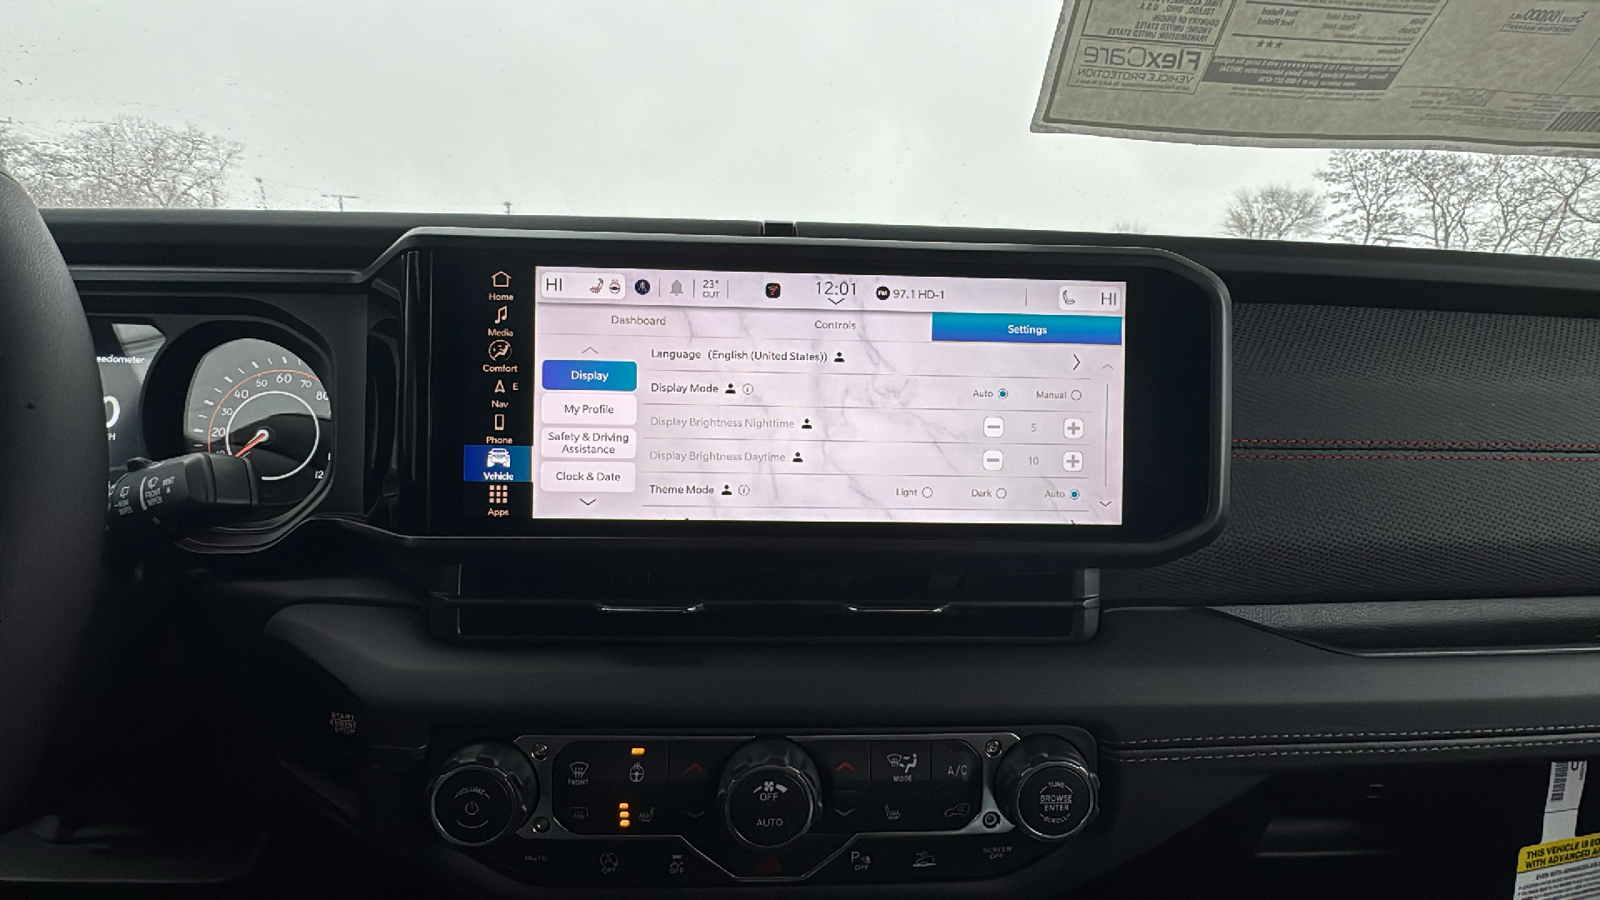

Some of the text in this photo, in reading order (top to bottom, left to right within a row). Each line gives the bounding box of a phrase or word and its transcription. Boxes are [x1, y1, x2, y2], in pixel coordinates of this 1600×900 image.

[546, 278, 563, 292] HI
[815, 281, 857, 296] 12:01
[488, 292, 514, 302] Home
[893, 289, 945, 300] 97.1 HD-1
[1101, 292, 1117, 306] HI
[611, 315, 667, 327] Dashboard
[814, 320, 857, 331] Controls
[487, 328, 514, 337] Media
[1007, 324, 1048, 336] Settings
[96, 354, 145, 364] eedometer
[651, 349, 828, 364] Language (English (United States))
[482, 364, 518, 374] Comfort
[276, 373, 292, 383] 60
[571, 370, 609, 383] Display
[255, 379, 268, 387] 50
[300, 380, 312, 388] 70
[513, 383, 519, 391] E
[651, 383, 719, 394] Display Mode
[234, 389, 249, 399] 40
[973, 389, 994, 399] Auto
[1036, 390, 1067, 400] Manual
[491, 400, 509, 409] Nav
[564, 404, 614, 415] My Profile
[221, 407, 233, 416] 30
[651, 417, 795, 429] Display Brightness Nighttime
[1030, 423, 1038, 433] 5
[211, 427, 226, 437] 20
[486, 436, 513, 445] Phone
[548, 432, 629, 446] Safety & Driving
[561, 444, 615, 455] Assistance
[650, 451, 786, 464] Display Brightness Daytime
[1028, 456, 1039, 466] 10
[483, 471, 514, 481] Vehicle
[555, 472, 621, 482] Clock & Date
[650, 485, 715, 495] Theme Mode
[896, 487, 918, 499] Light
[971, 488, 993, 498] Dark
[1044, 489, 1066, 499] Auto
[487, 508, 510, 518] Apps
[947, 764, 968, 777] A/C
[567, 778, 589, 786] FRONT
[893, 775, 913, 783] MODE
[1047, 781, 1066, 789] TUNE
[458, 786, 486, 796] VOLUME
[759, 792, 779, 801] OFF
[1040, 794, 1072, 802] BROWSE
[1044, 804, 1070, 812] ENTER
[756, 817, 784, 827] AUTO
[1042, 815, 1069, 824] SCROLL
[1526, 848, 1545, 859] THIS
[1546, 842, 1580, 855] VEHICLE
[1581, 839, 1589, 848] IS
[525, 854, 547, 862] MUTE
[1525, 858, 1547, 869] WITH
[1548, 849, 1591, 864] ADVANCED
[669, 866, 685, 875] OFF
